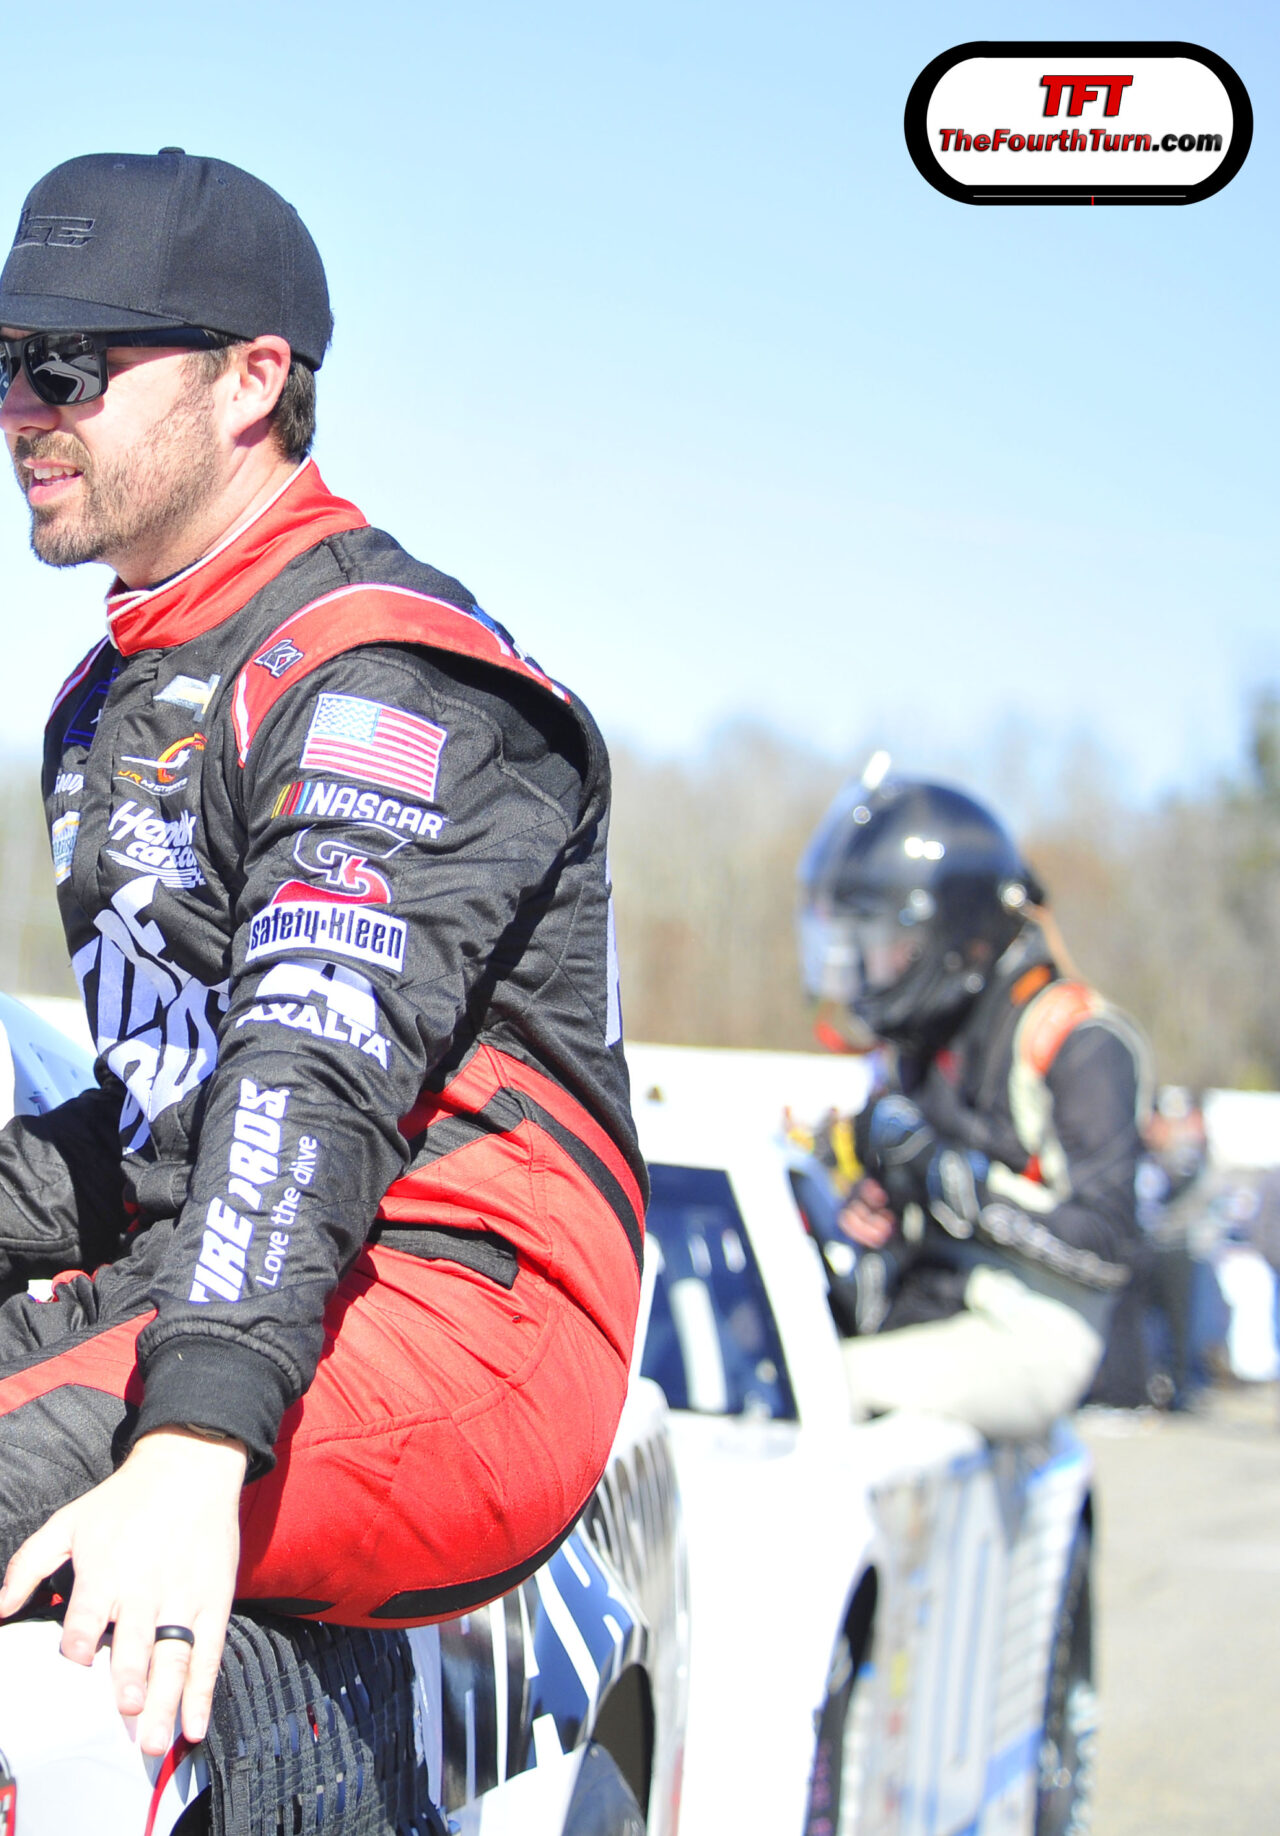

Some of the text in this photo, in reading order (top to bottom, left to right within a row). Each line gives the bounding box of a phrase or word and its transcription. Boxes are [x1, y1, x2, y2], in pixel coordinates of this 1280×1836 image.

[305, 782, 443, 839] NASCAR
[235, 1003, 388, 1071] AXALTA
[271, 1186, 300, 1225] the
[256, 1231, 288, 1287] Love
